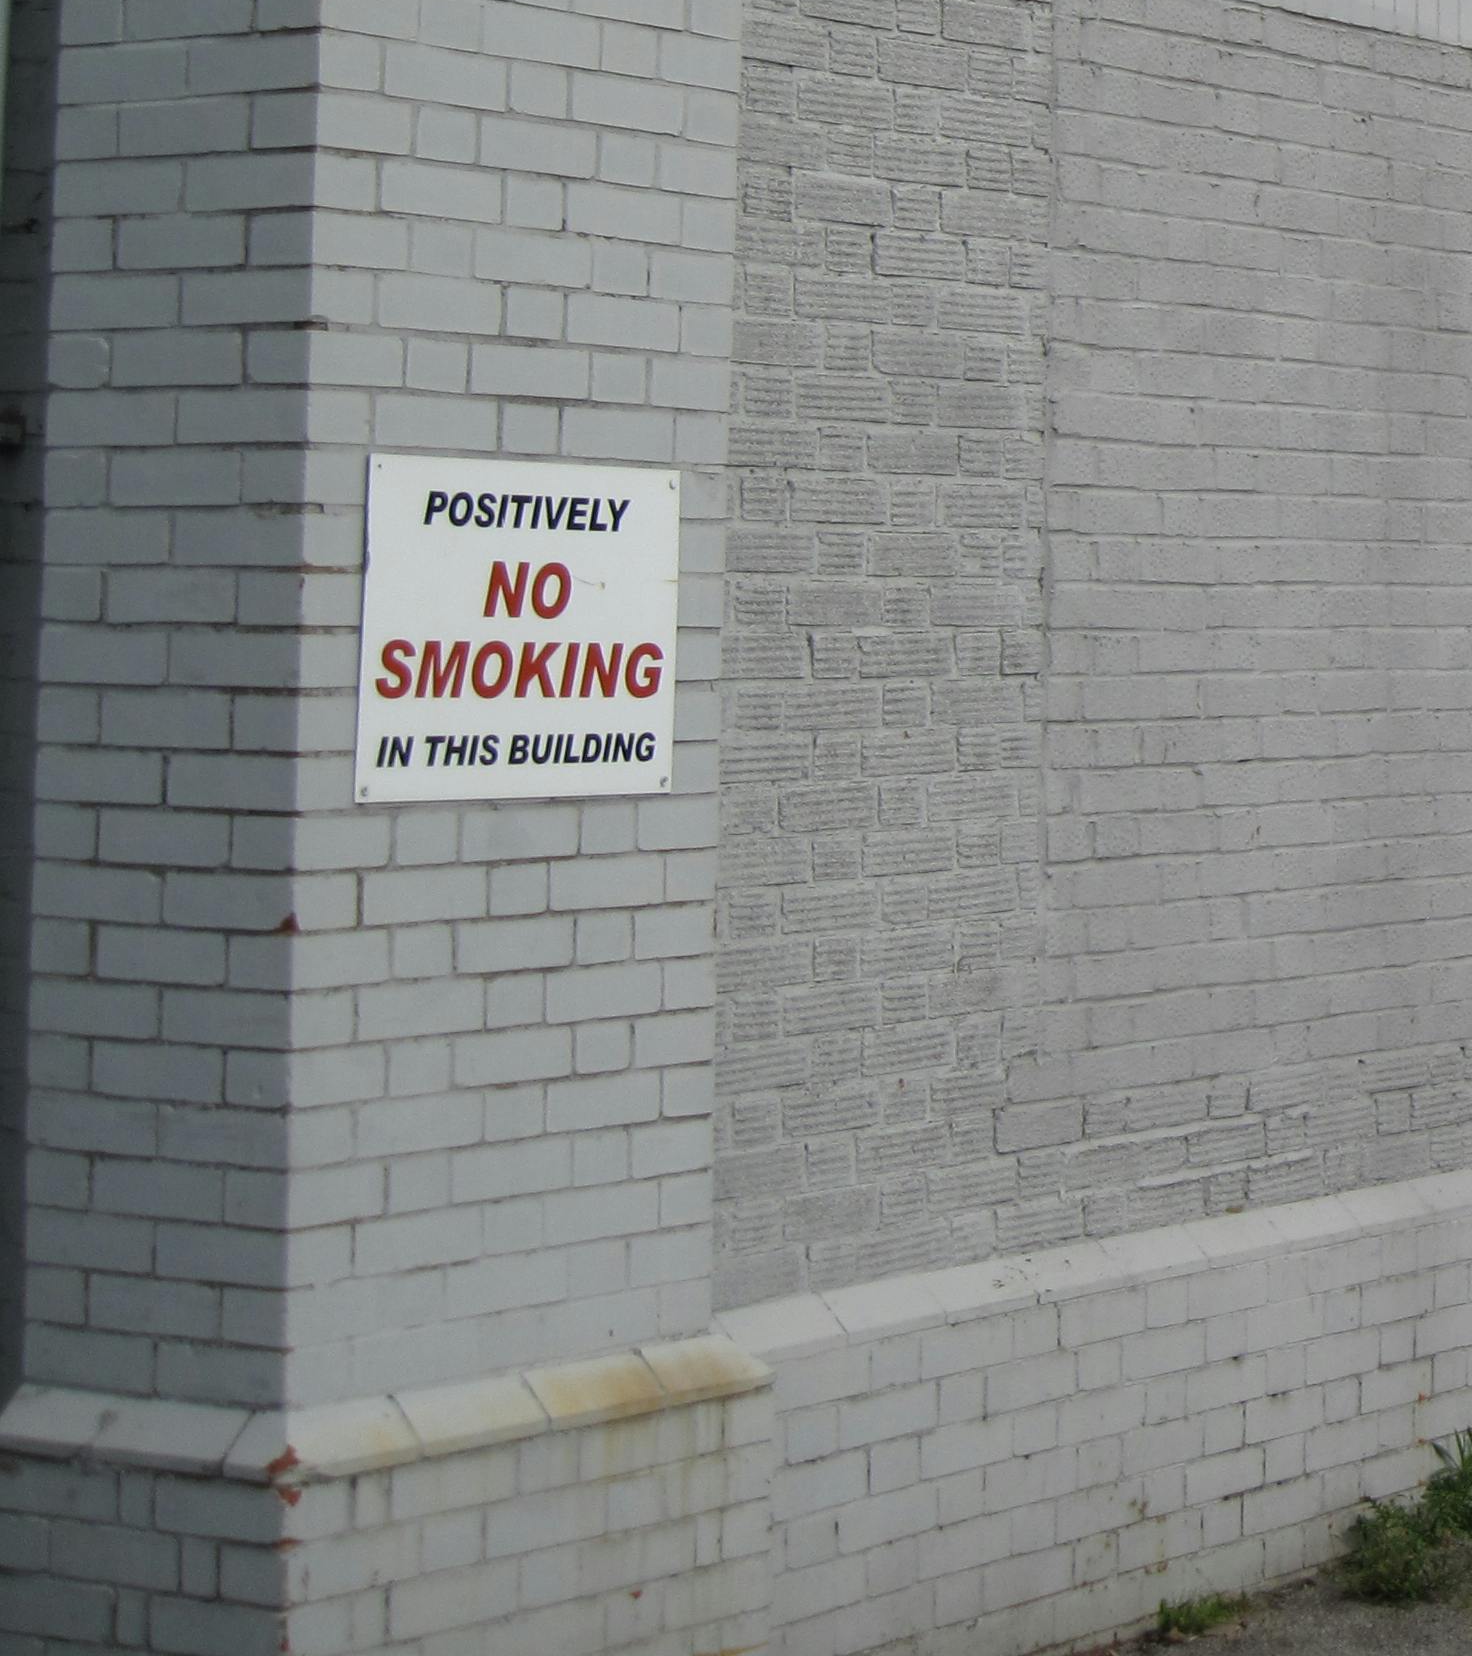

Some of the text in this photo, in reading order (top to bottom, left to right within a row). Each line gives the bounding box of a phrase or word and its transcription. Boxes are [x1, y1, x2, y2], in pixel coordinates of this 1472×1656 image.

[424, 490, 631, 532] POSITIVELY
[483, 561, 572, 619] NO
[375, 639, 664, 699] SMOKING
[376, 732, 656, 768] IN THIS BUILDING
